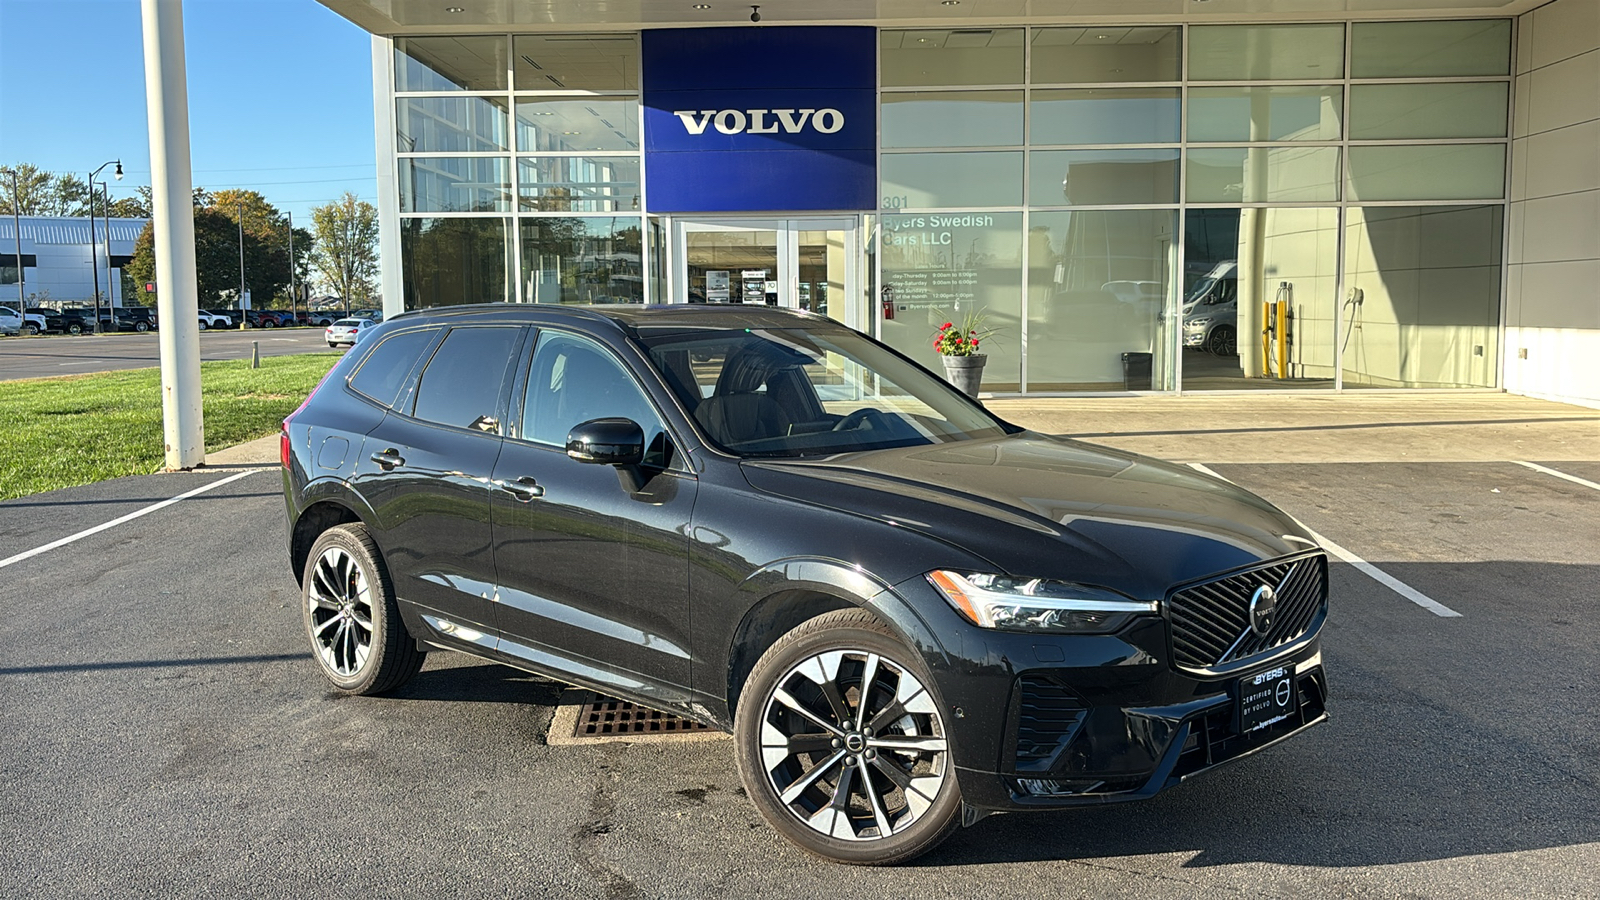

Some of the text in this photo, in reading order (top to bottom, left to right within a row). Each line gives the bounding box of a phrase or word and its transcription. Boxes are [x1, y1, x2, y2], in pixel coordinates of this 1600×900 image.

[673, 108, 845, 135] VOLVO
[882, 195, 908, 209] 301
[882, 215, 993, 231] Byers Swedish
[882, 232, 952, 246] Cars LLC
[1254, 667, 1284, 685] BYERS
[1243, 700, 1271, 716] BY VOLVO
